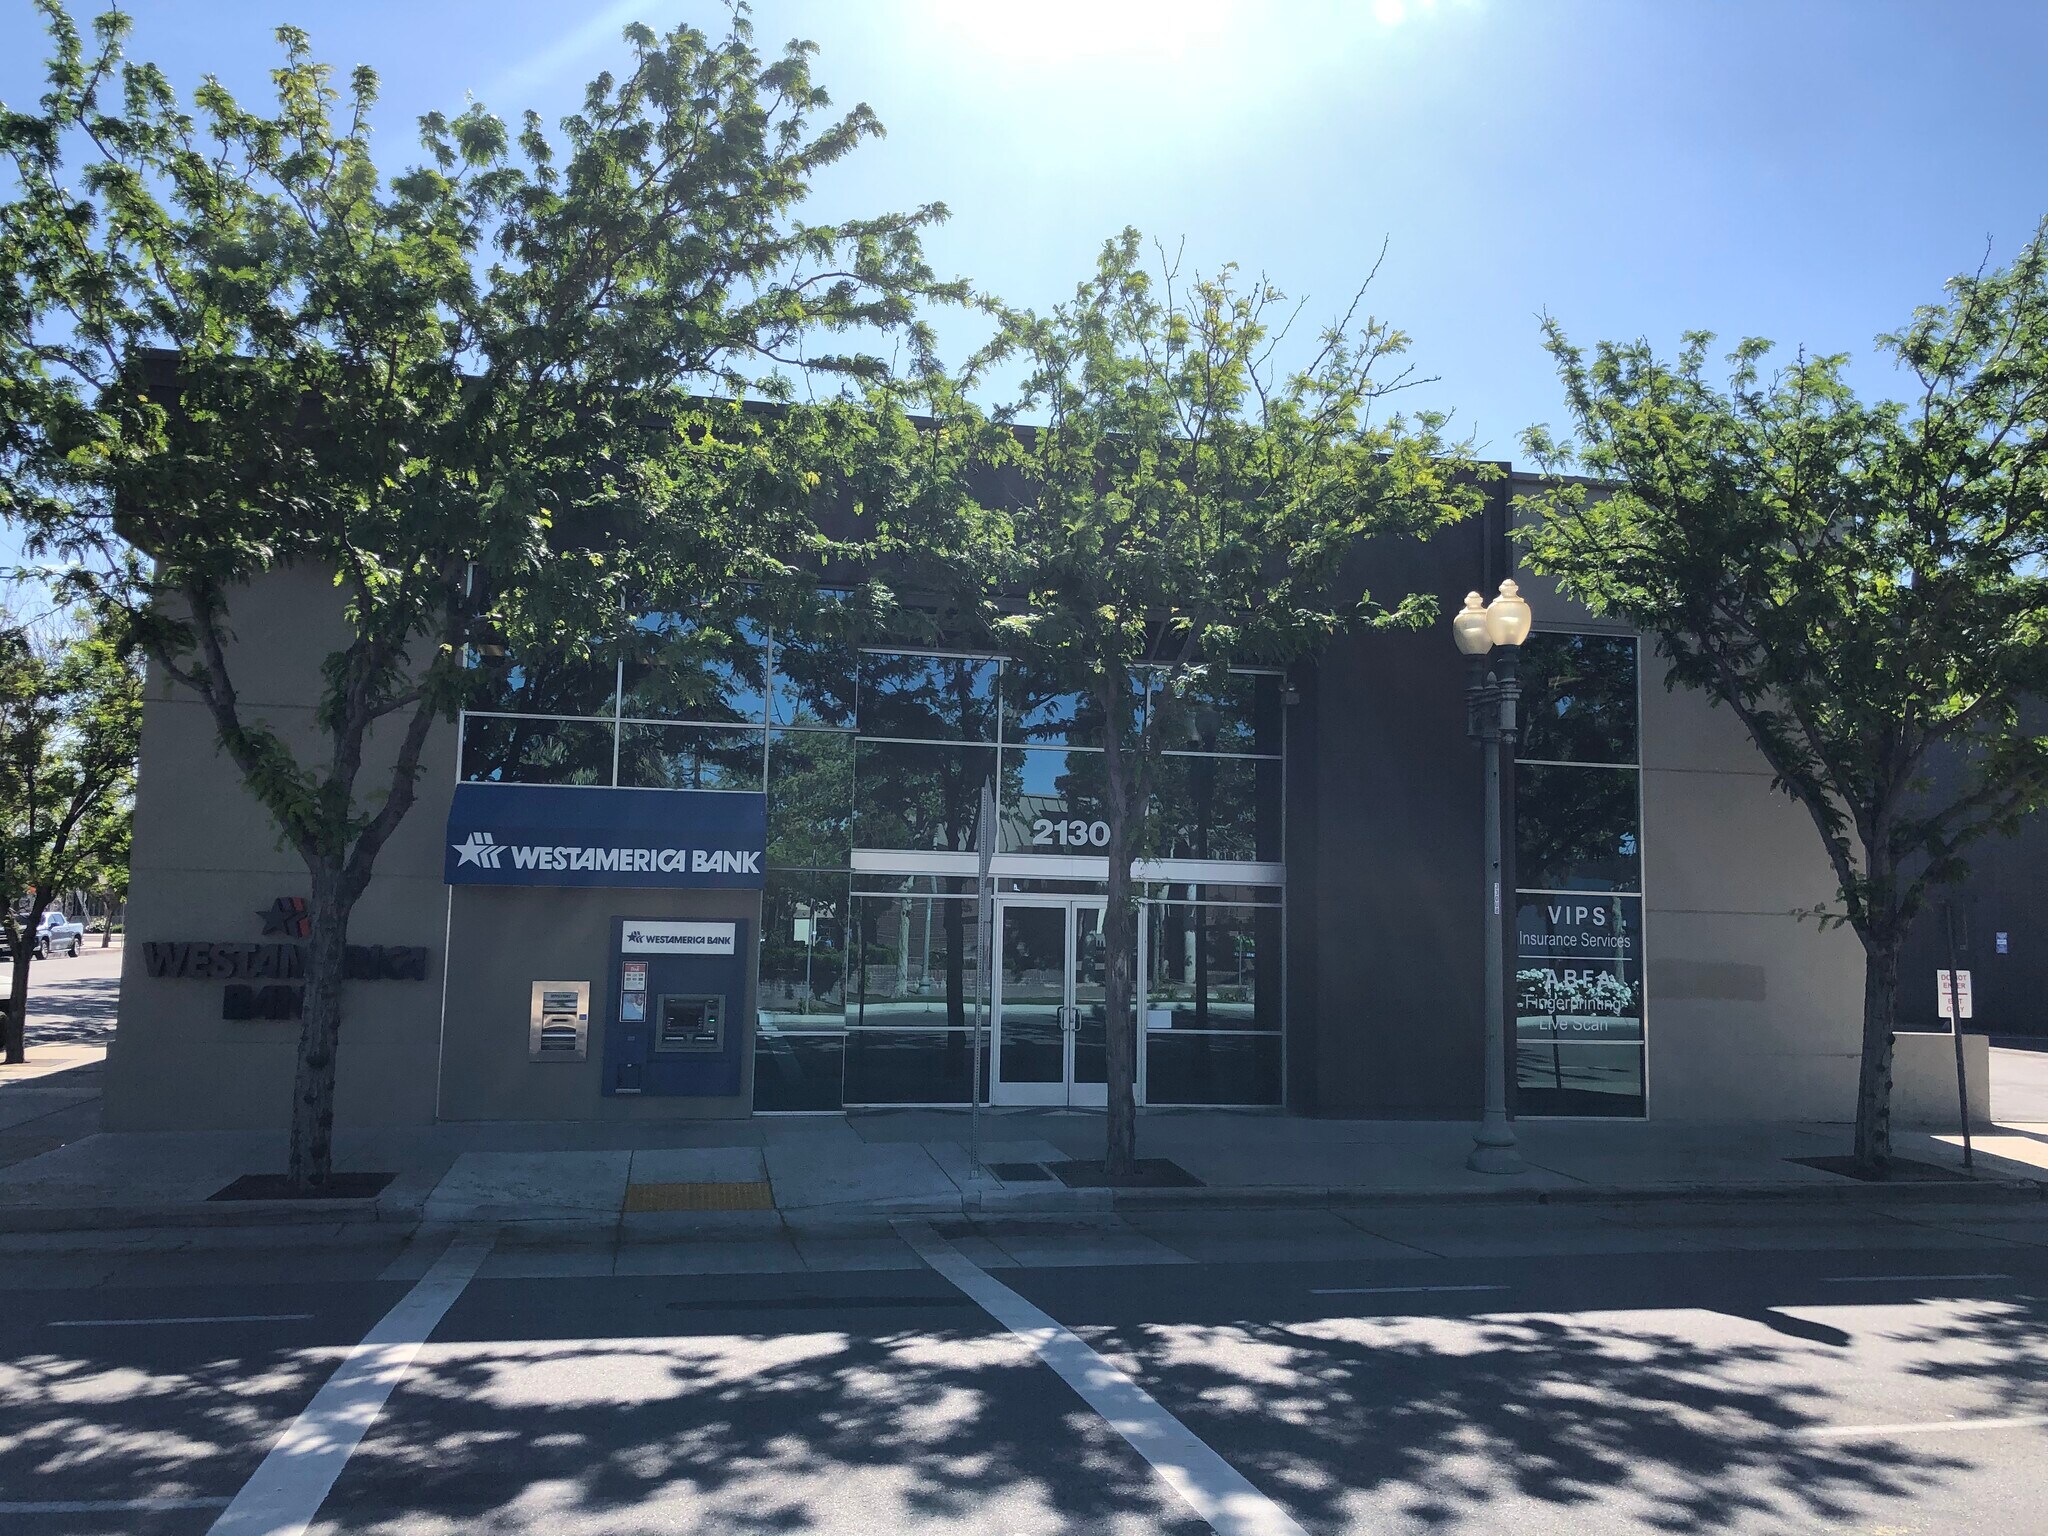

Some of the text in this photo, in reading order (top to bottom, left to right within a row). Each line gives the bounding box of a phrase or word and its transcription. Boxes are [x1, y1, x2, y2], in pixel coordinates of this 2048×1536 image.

[1033, 819, 1111, 847] 2130
[511, 845, 761, 874] WESTAMERICA BANK
[1548, 906, 1606, 926] VIPS
[645, 935, 731, 945] WESTAMERICA BANK
[1519, 930, 1631, 948] Insurance Services
[141, 942, 427, 980] WESTAMRICA
[222, 984, 304, 1020] BAN
[1524, 994, 1621, 1015] Fingerprinting
[1539, 1018, 1608, 1031] Live Scan
